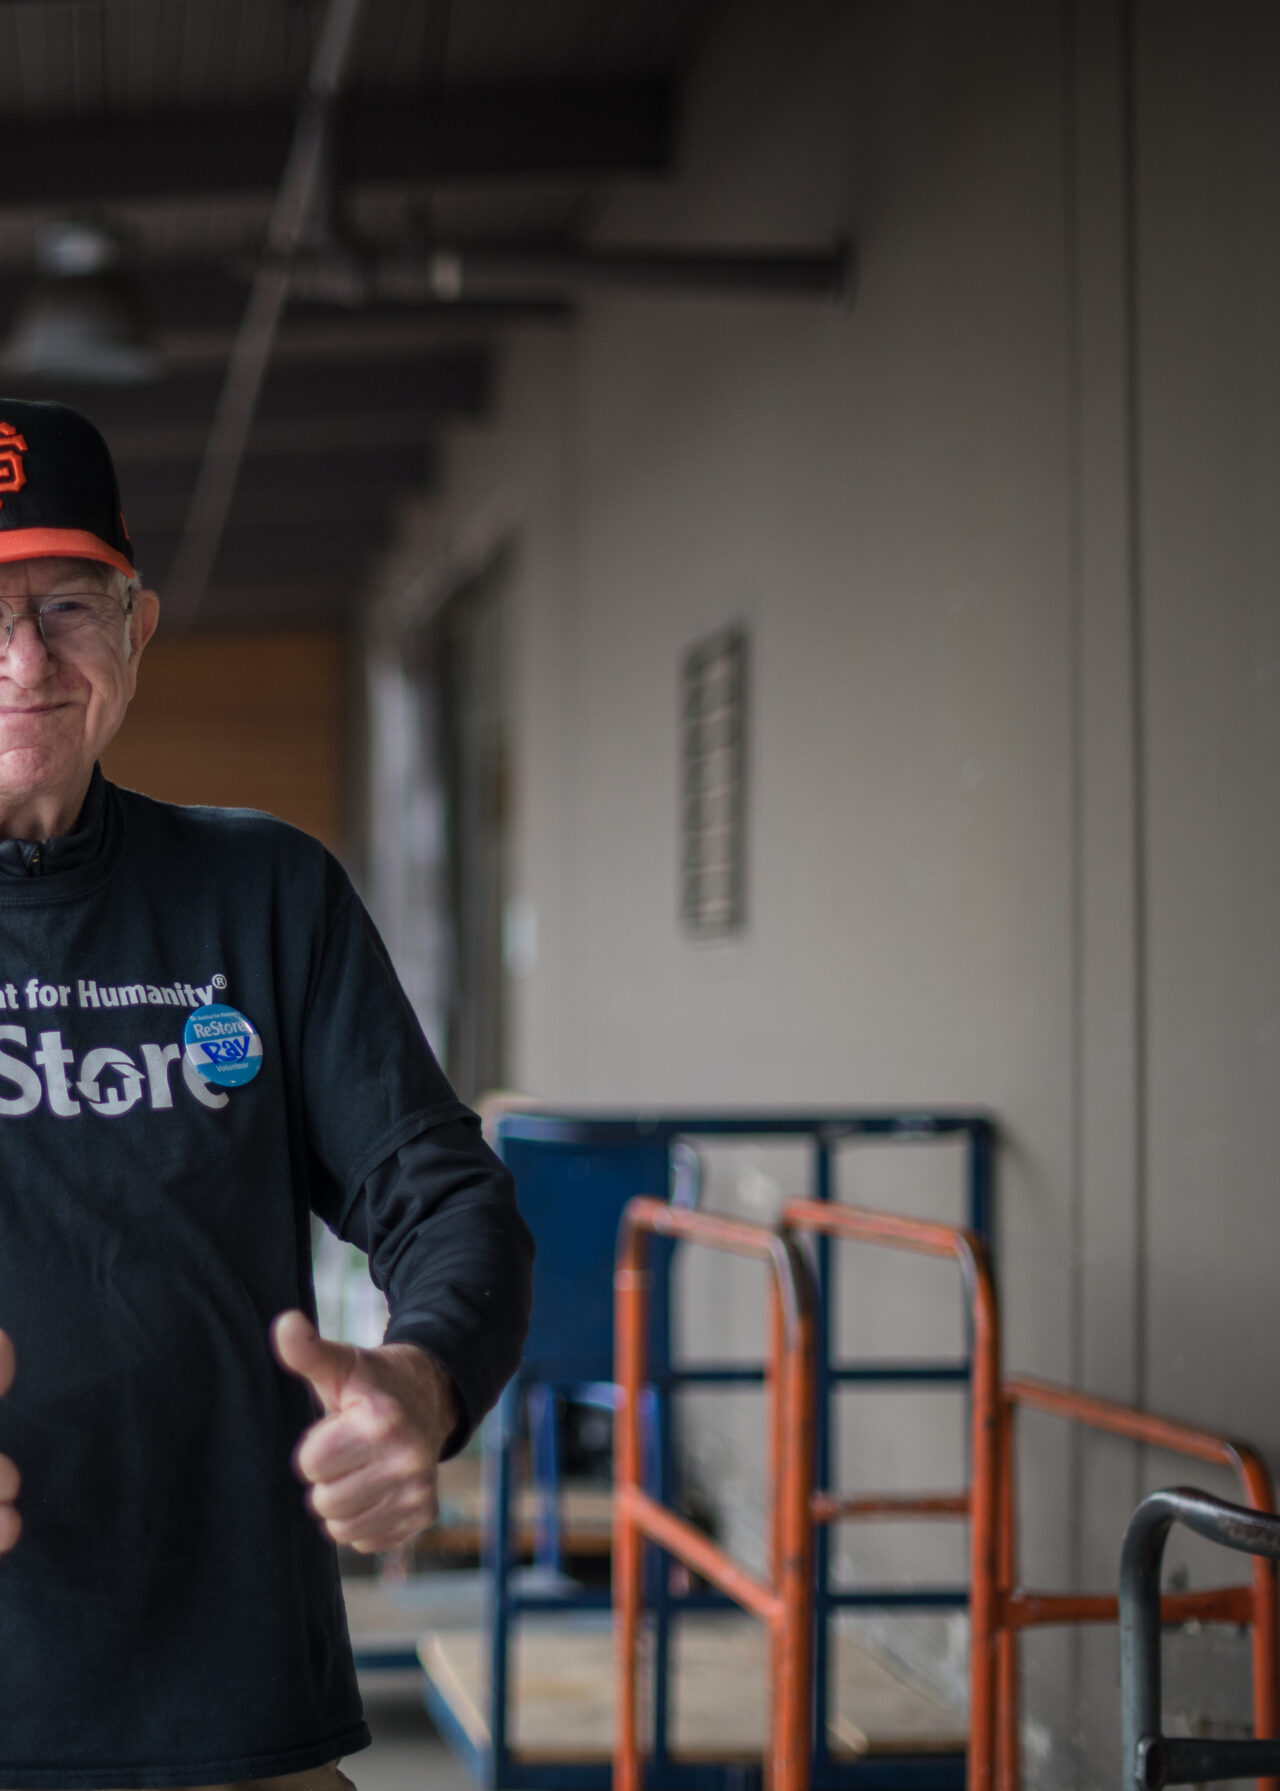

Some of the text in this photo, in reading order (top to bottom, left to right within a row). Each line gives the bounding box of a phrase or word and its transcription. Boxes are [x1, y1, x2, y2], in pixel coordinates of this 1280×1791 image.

[25, 978, 71, 1009] for
[193, 1020, 247, 1038] ReStore
[200, 1035, 250, 1064] Ray
